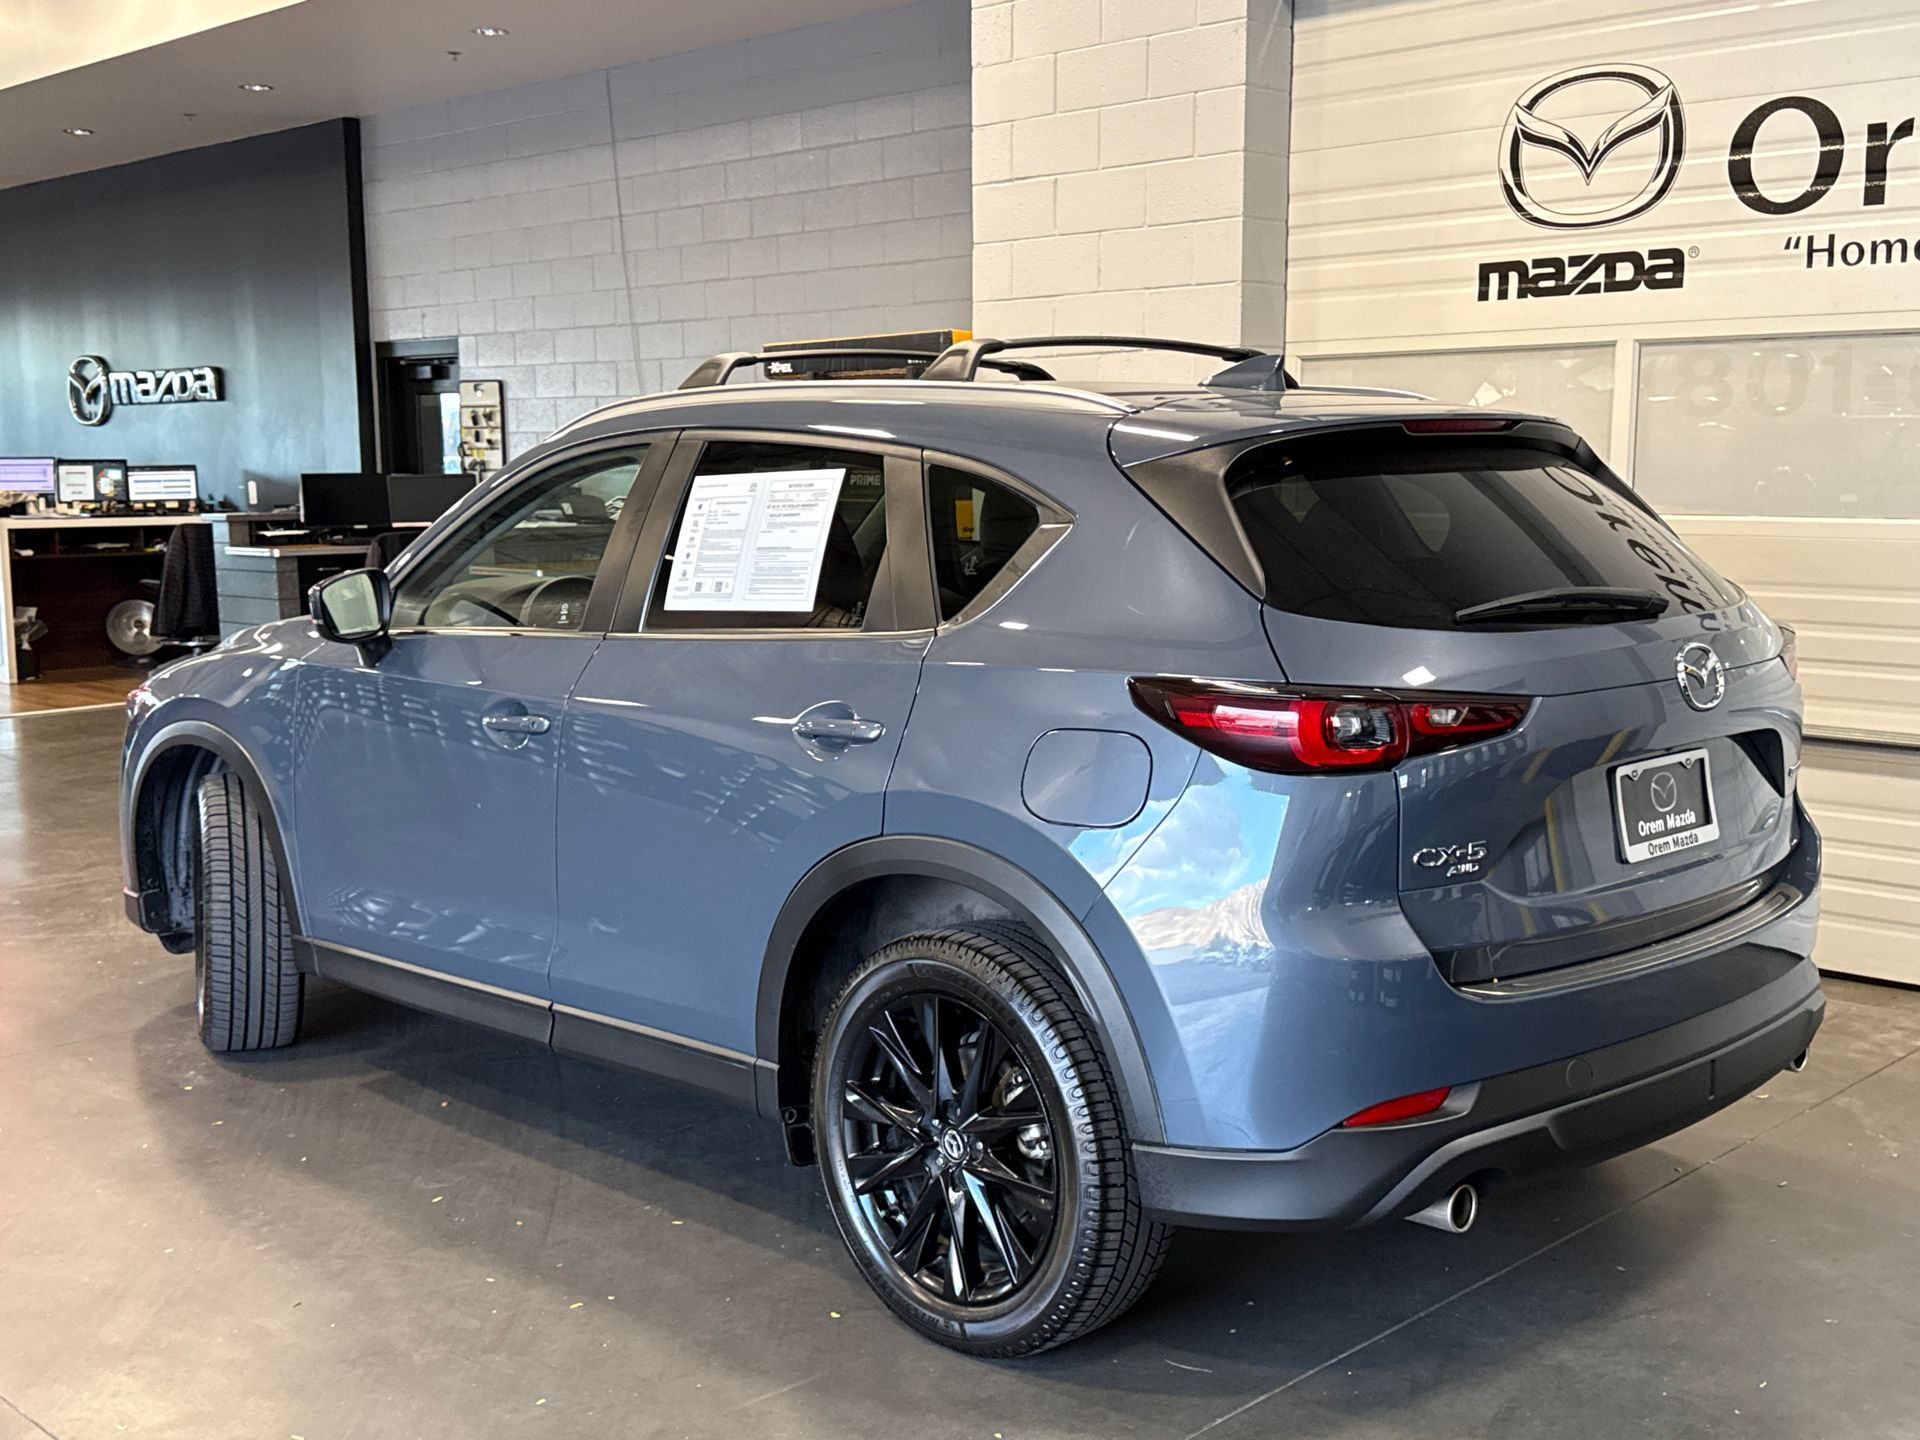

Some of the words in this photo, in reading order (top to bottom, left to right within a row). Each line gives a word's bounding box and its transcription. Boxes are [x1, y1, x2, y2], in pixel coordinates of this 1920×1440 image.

[1784, 233, 1920, 269] “Hom
[850, 474, 882, 486] PRIME
[1637, 817, 1665, 837] Orem
[1666, 808, 1697, 829] Mazda
[1413, 840, 1488, 867] CX-5
[1647, 839, 1672, 856] Orem
[1672, 831, 1699, 850] Mazda
